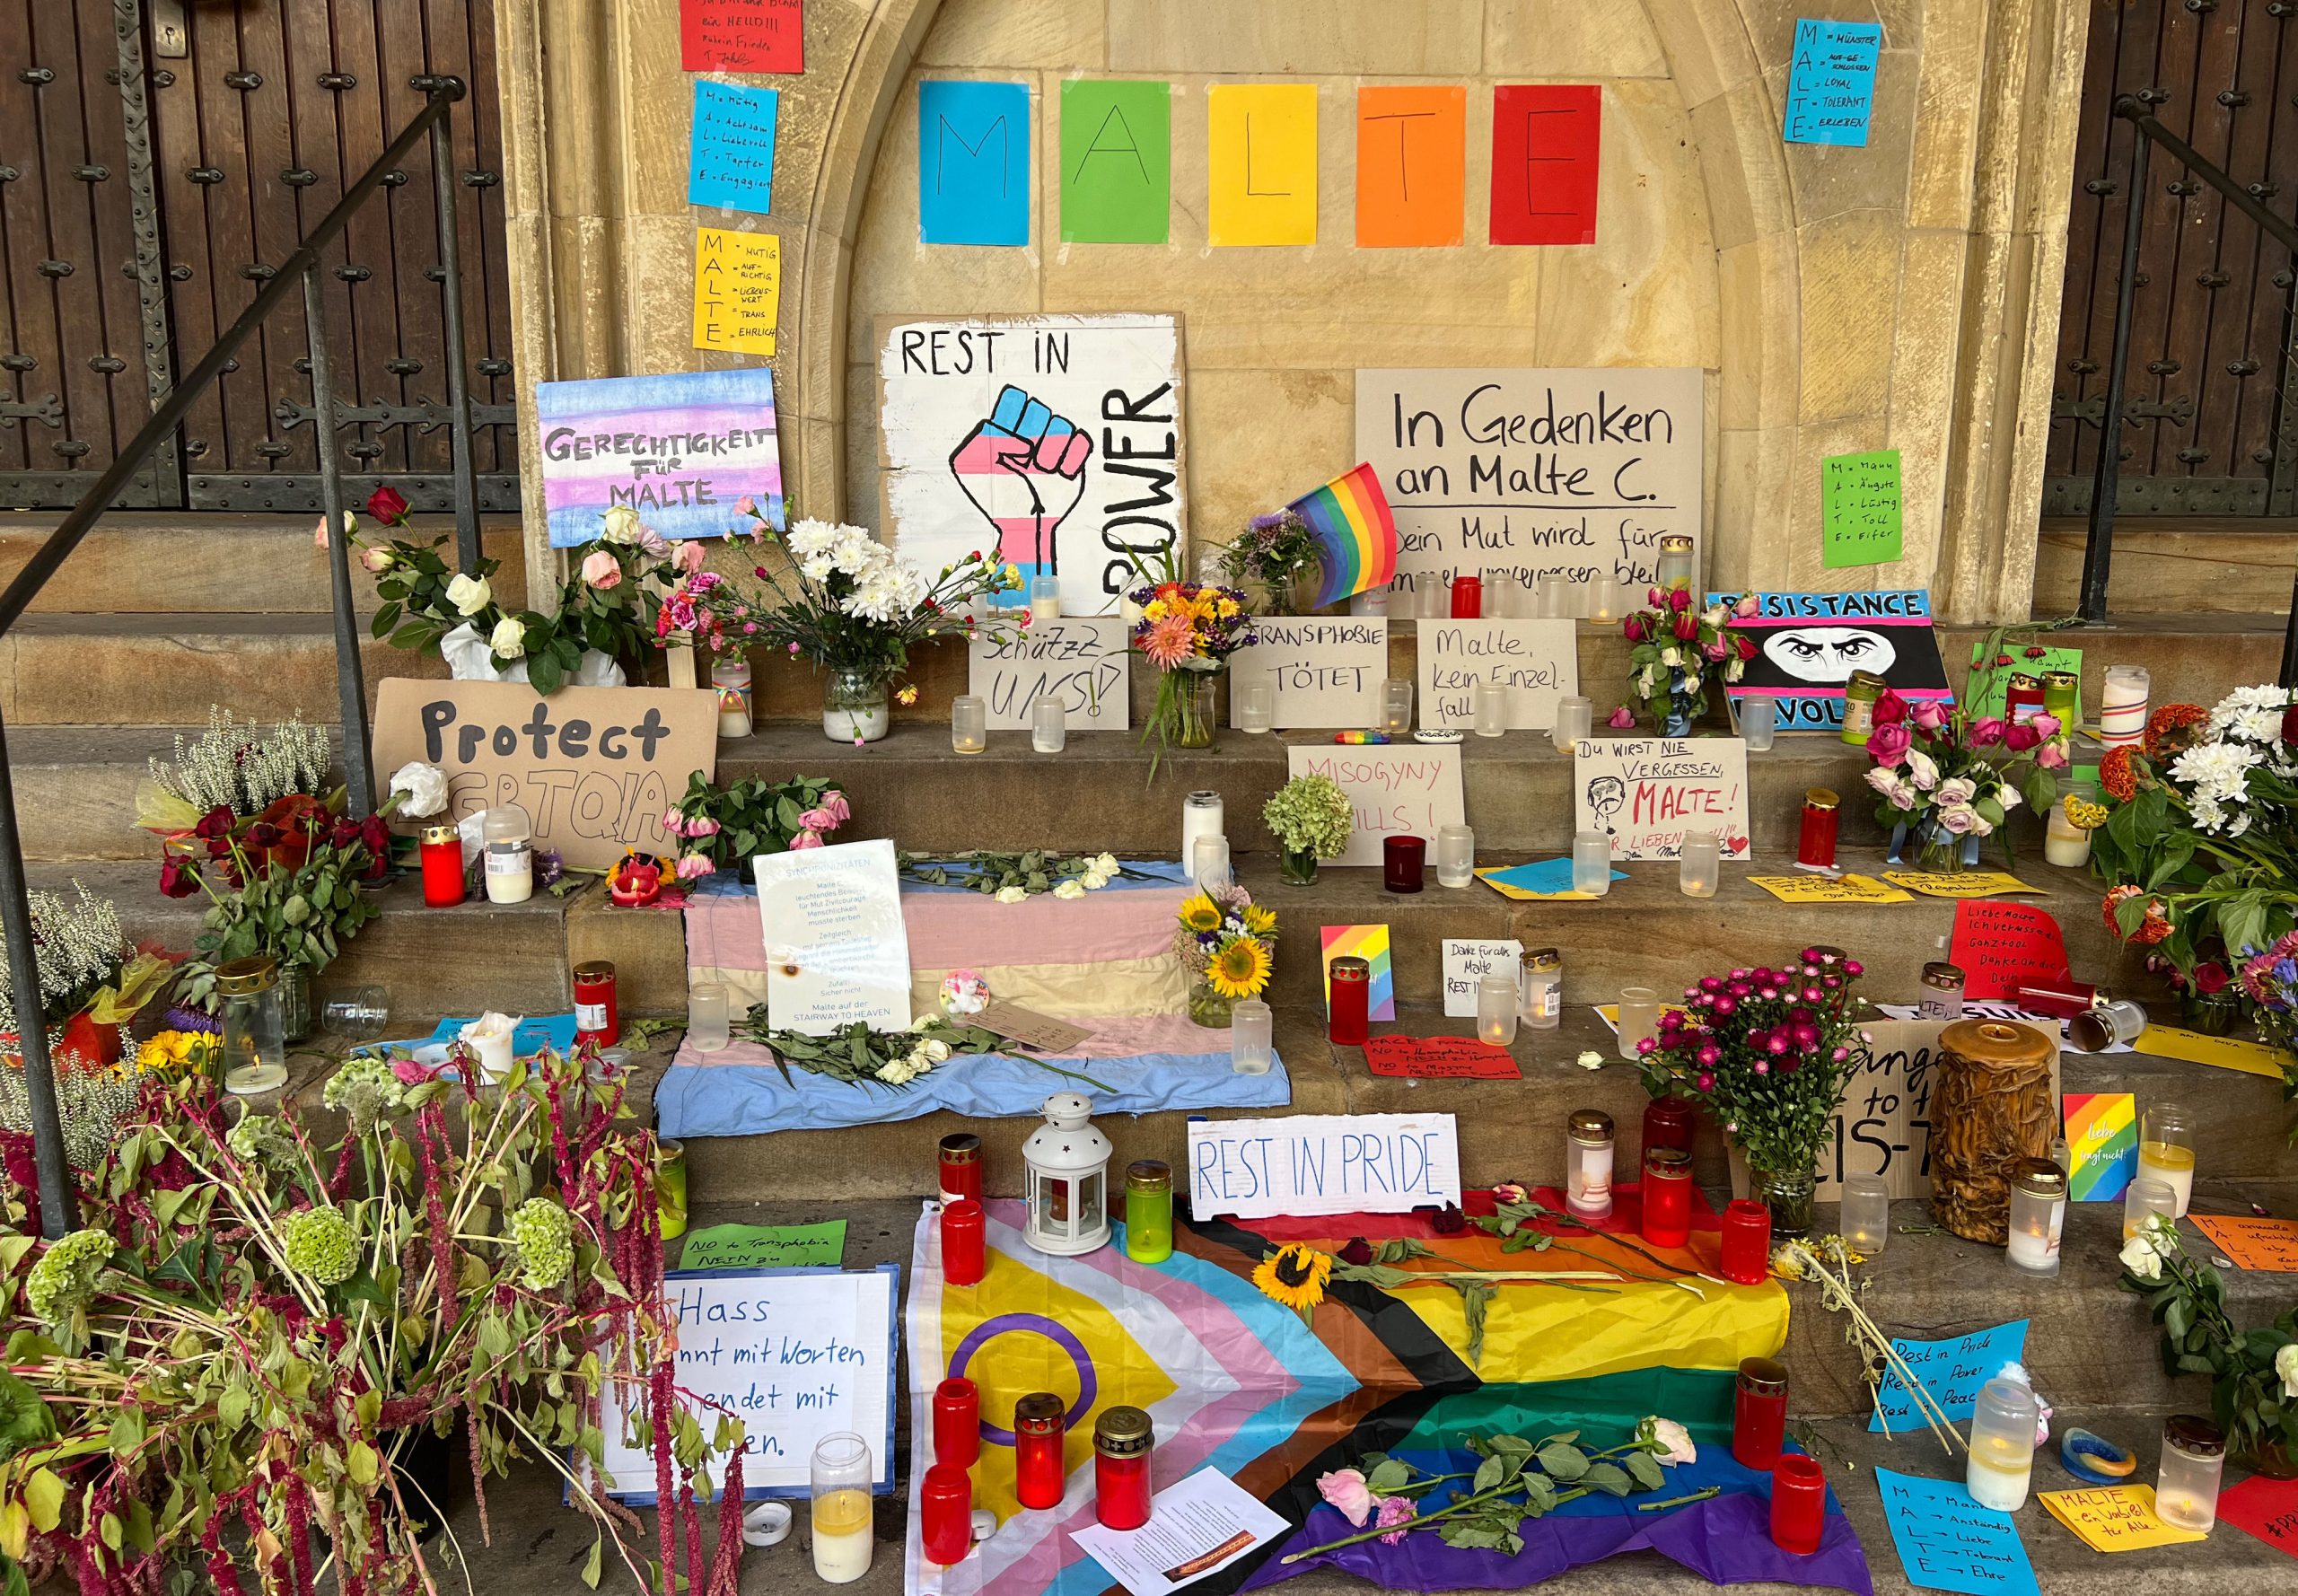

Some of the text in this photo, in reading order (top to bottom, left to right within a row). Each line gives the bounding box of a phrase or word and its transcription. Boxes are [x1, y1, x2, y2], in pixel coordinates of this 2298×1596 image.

[1825, 77, 1851, 89] LOYAL
[1823, 95, 1865, 108] TOLERANT
[902, 330, 1004, 374] REST
[1394, 384, 1672, 448] In Gedenken
[545, 427, 776, 461] GERECHTIGKEIT
[1395, 453, 1657, 501] an Malte C.
[610, 478, 718, 511] MALTE
[1862, 513, 1888, 524] Toll
[1461, 515, 1515, 549] Mut
[1533, 517, 1596, 548] wird
[1719, 593, 1924, 617] RSISTANCE
[1437, 629, 1534, 657] Malte,
[1267, 662, 1372, 692] TÖTET
[421, 700, 671, 763] Protect
[1613, 741, 1653, 757] WIRST
[1661, 741, 1688, 755] NIE
[1308, 758, 1442, 791] MISOGYNY
[1355, 805, 1412, 831] ILLS
[1631, 831, 1682, 851] LIEBEN
[835, 914, 862, 923] sterben
[1968, 905, 1999, 918] Liebe
[819, 930, 851, 940] Zeitgleich
[1452, 944, 1477, 956] Danke
[1464, 960, 1491, 975] Malte
[1448, 977, 1471, 994] REST
[794, 1013, 838, 1022] STAIRWAY
[855, 1008, 890, 1018] HEAVEN
[1864, 1087, 1899, 1118] to
[2089, 1120, 2117, 1141] Liebe
[1197, 1134, 1443, 1199] REST IN PRIDE
[689, 1241, 717, 1250] NO
[748, 1238, 829, 1249] Transphobia
[697, 1255, 751, 1266] NEIN
[679, 1287, 770, 1325] Hass
[733, 1337, 772, 1364] mit
[780, 1336, 864, 1366] Worten
[1937, 1349, 1949, 1359] in
[1928, 1376, 1937, 1386] in
[796, 1383, 839, 1409] mit
[1943, 1390, 1977, 1406] Peac
[1893, 1486, 1909, 1498] M
[2059, 1488, 2129, 1508] MALTE
[1901, 1506, 2011, 1534] A Anständig
[1908, 1525, 1994, 1546] L Liebe
[1913, 1541, 1935, 1554] T
[1917, 1557, 2006, 1581] E Ehre
